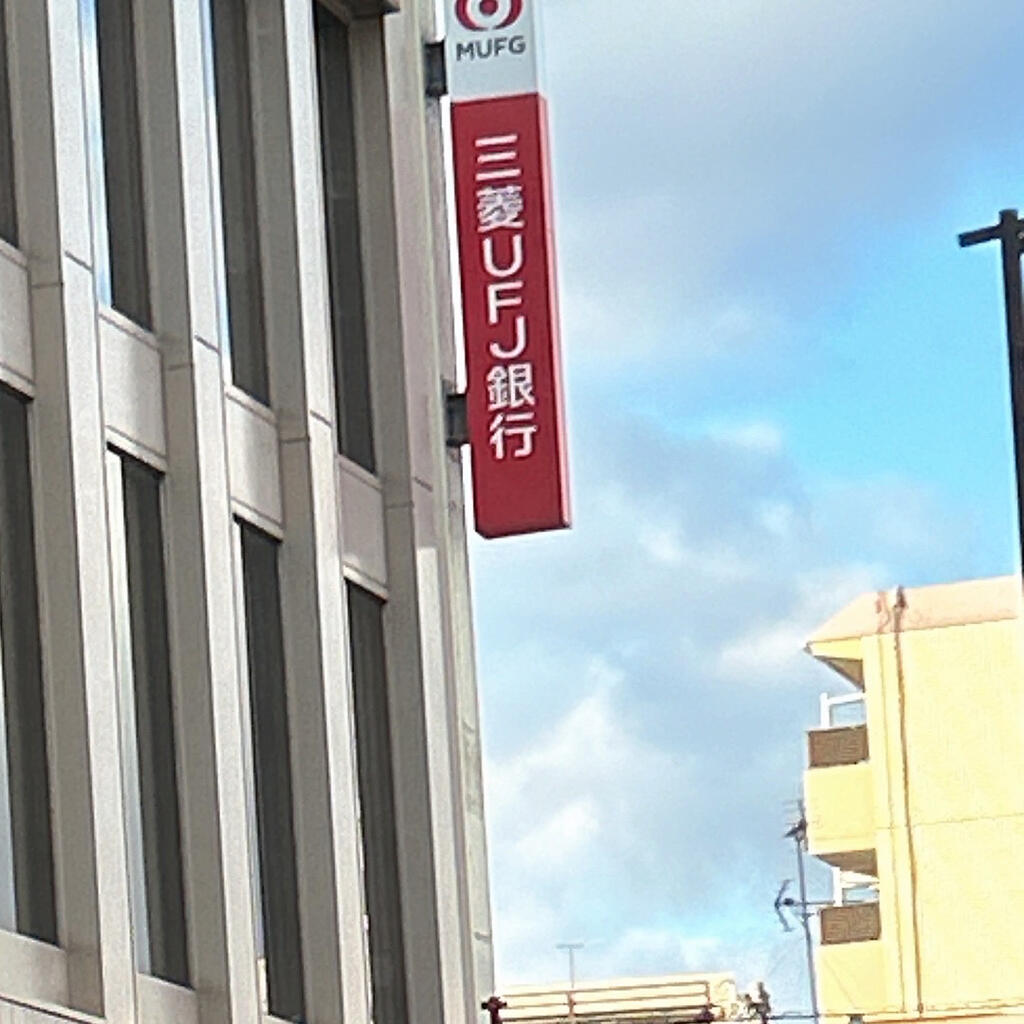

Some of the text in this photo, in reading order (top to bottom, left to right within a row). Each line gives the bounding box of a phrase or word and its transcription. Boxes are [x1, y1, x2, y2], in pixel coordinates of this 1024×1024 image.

[456, 35, 527, 61] MUFG
[475, 133, 539, 460] 三菱UFJ銀行
